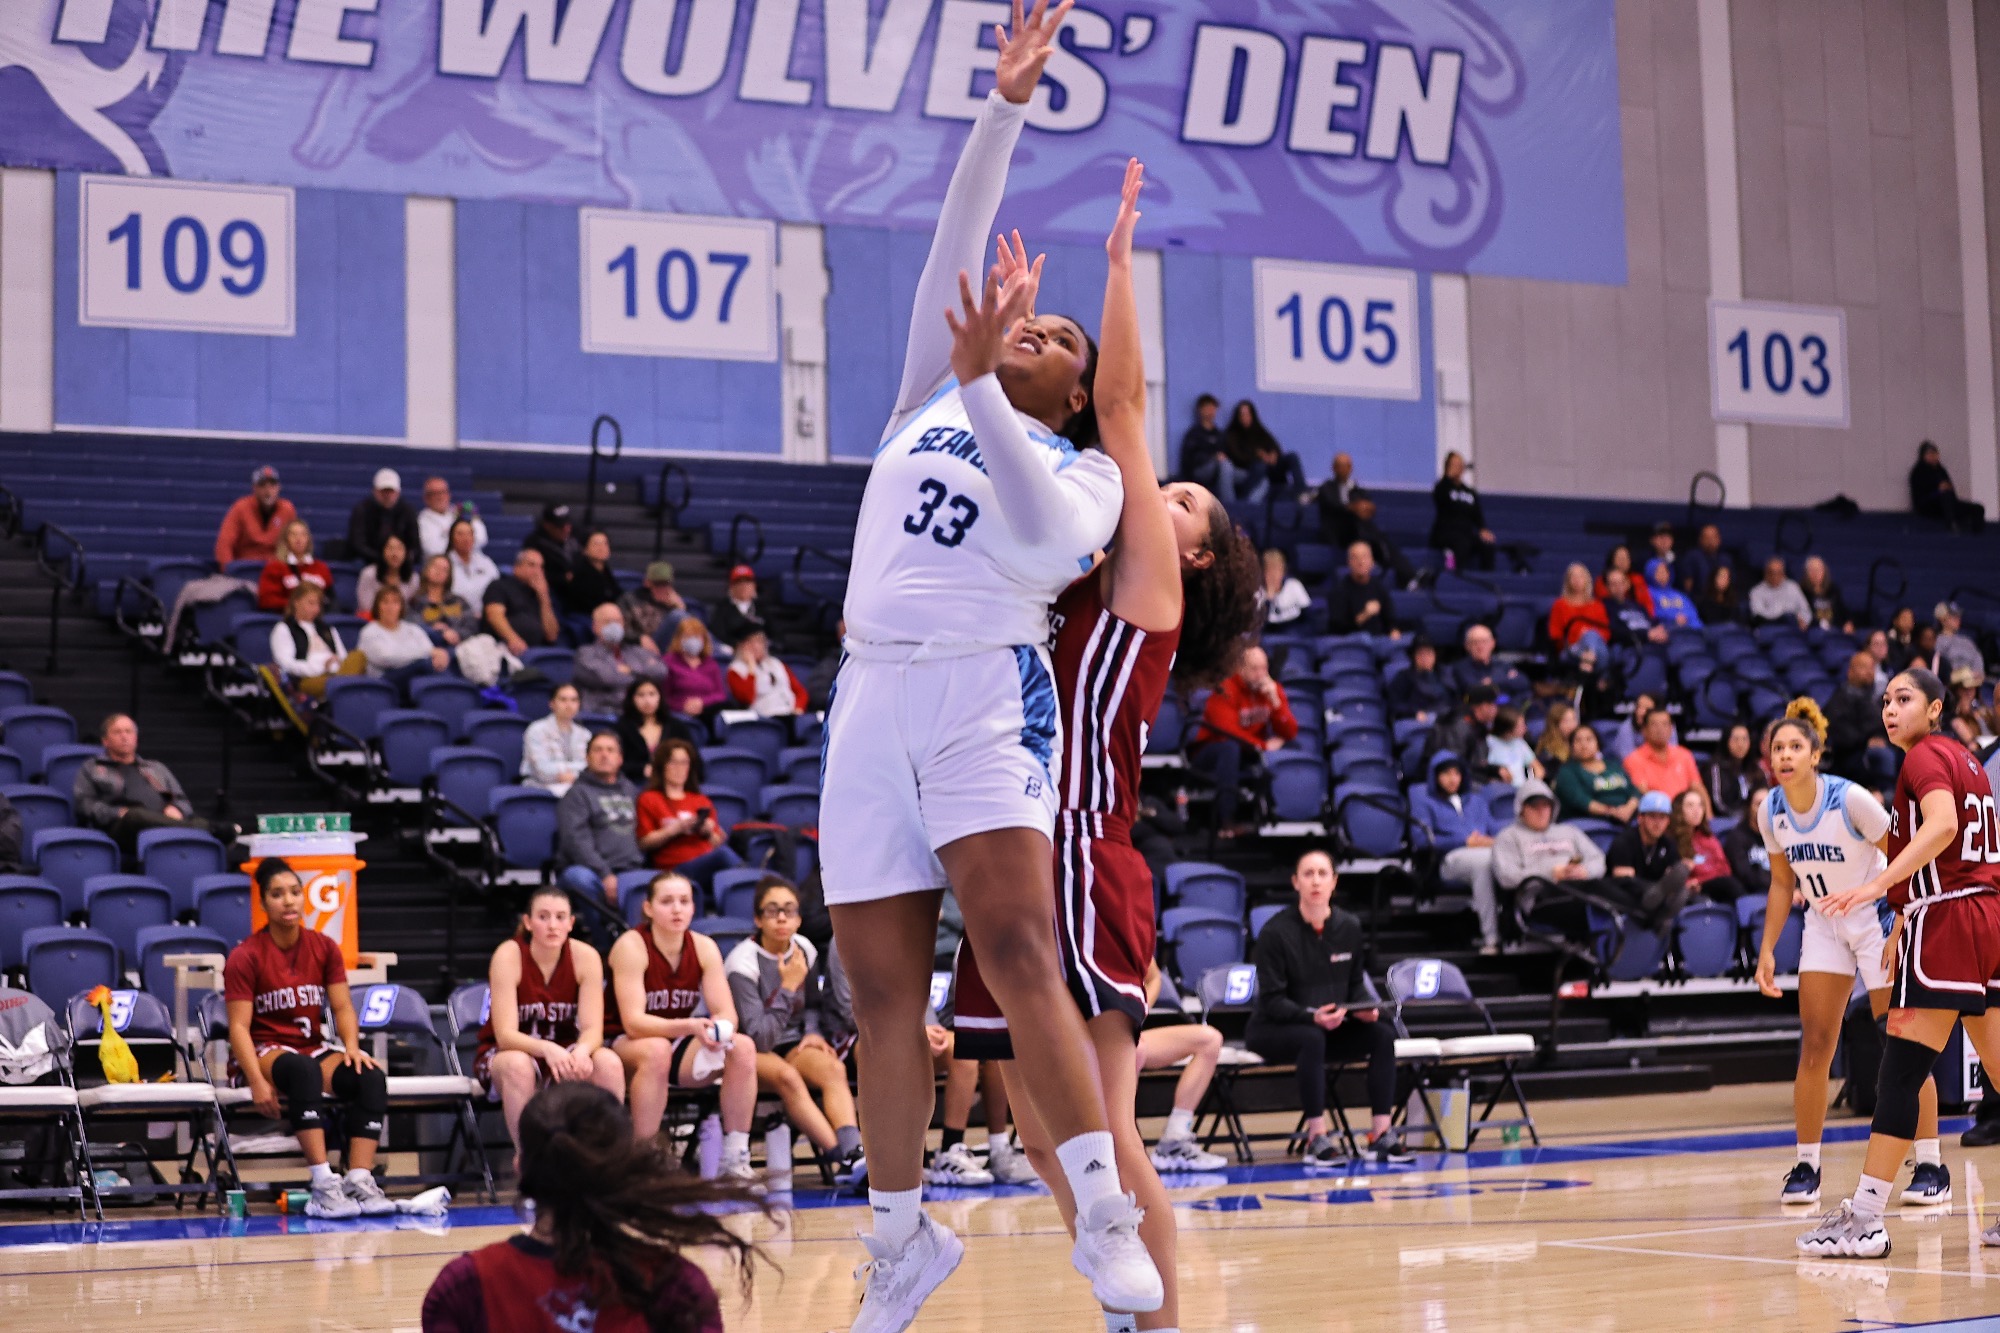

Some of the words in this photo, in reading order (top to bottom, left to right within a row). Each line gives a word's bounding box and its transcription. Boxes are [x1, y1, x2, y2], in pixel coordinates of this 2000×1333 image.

[1181, 23, 1464, 166] DEN
[107, 212, 267, 297] 109
[607, 245, 751, 324] 107
[1275, 292, 1398, 365] 105
[1727, 328, 1832, 397] 103
[904, 477, 979, 548] 33
[1786, 843, 1846, 863] EAWOLVES
[1961, 793, 2000, 864] 20
[309, 875, 340, 912] G
[1806, 872, 1829, 898] 11
[255, 986, 297, 1014] CHICO
[360, 986, 398, 1026] S
[1226, 966, 1256, 1003] S
[1415, 960, 1441, 998] S
